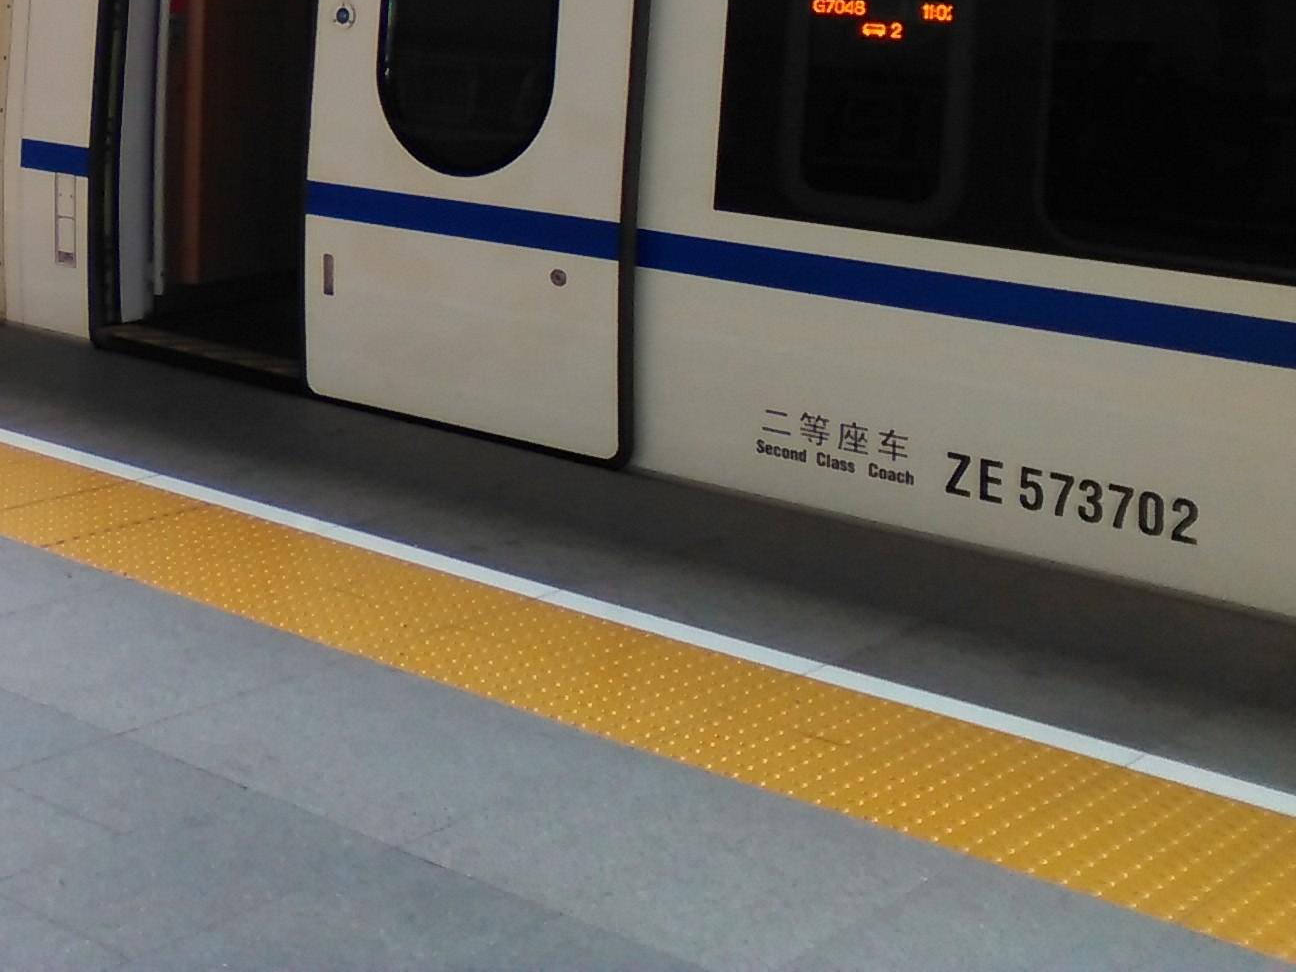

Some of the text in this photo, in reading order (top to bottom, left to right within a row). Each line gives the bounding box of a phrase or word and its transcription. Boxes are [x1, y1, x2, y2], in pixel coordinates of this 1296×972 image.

[890, 22, 903, 39] 2
[761, 408, 909, 461] 二等座车
[755, 439, 915, 486] Second Class Coach
[945, 451, 1200, 545] ZE 573702
